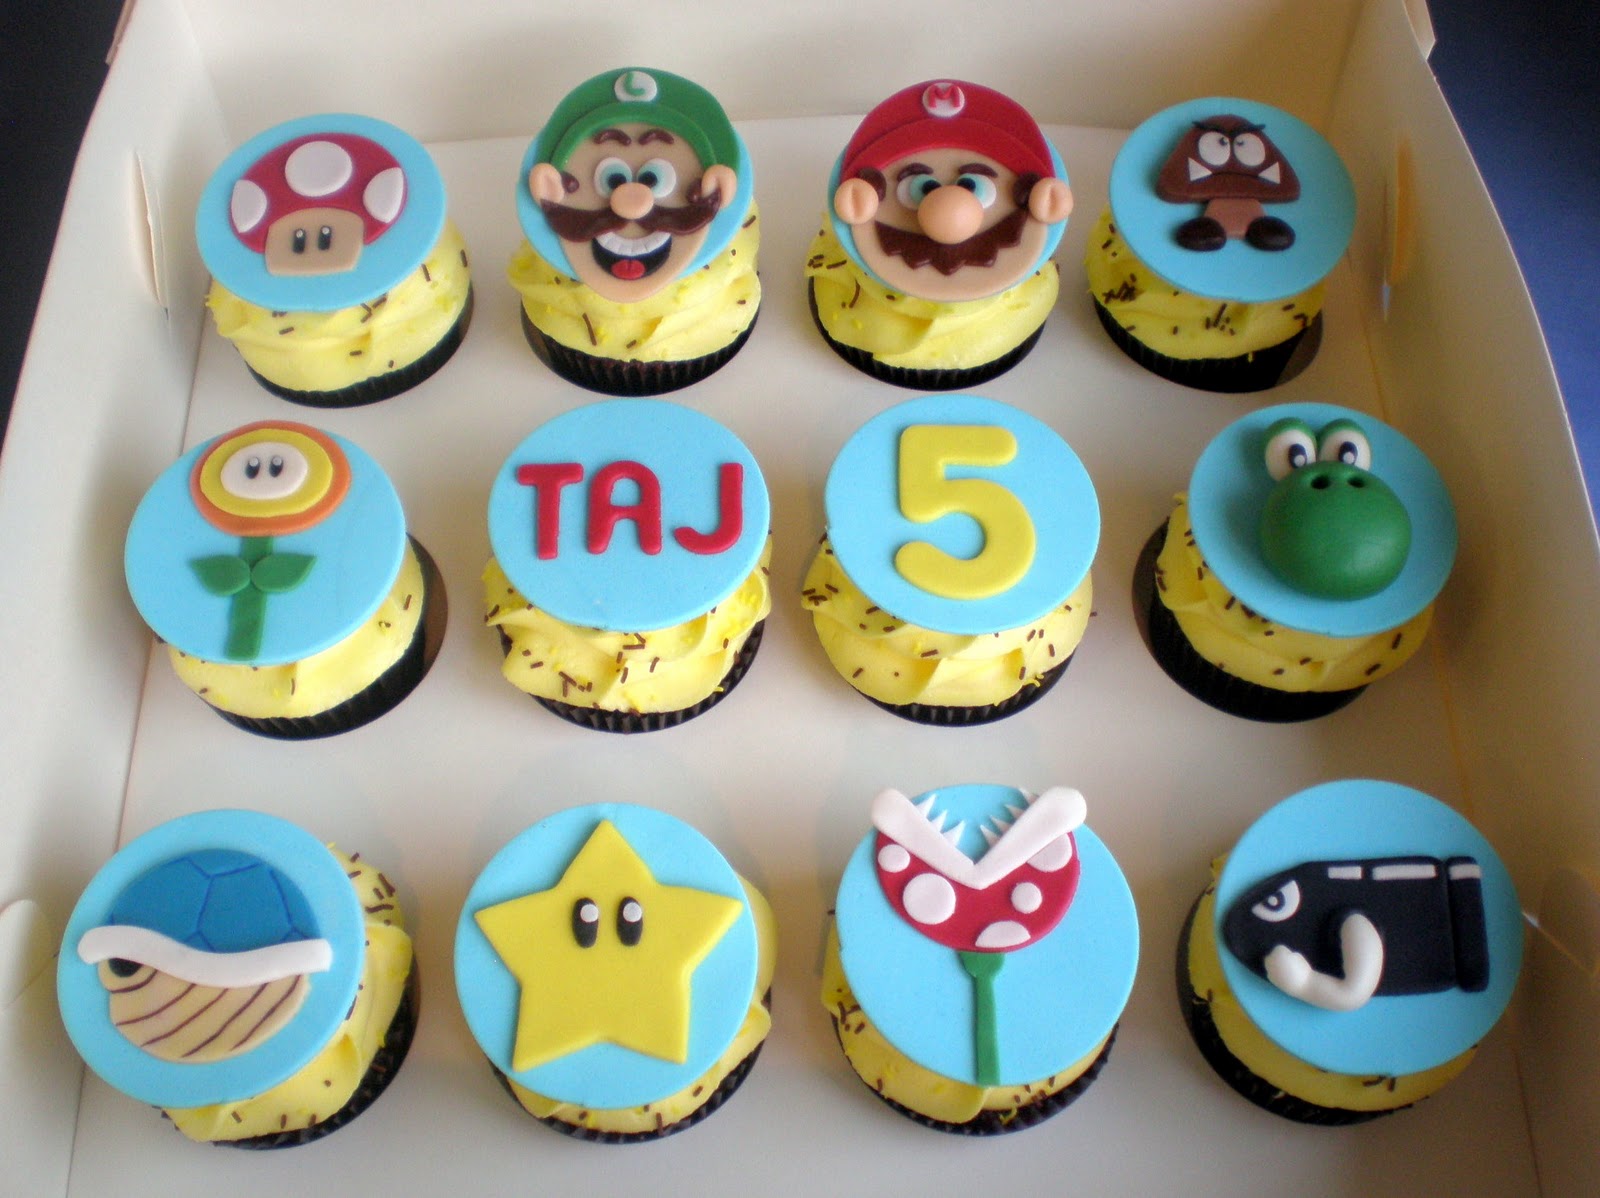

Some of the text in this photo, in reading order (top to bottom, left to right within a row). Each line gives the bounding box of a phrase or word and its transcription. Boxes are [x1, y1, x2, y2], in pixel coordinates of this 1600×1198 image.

[625, 71, 646, 96] L
[928, 84, 960, 108] M
[517, 460, 743, 560] TAJ
[895, 424, 1036, 599] 5
